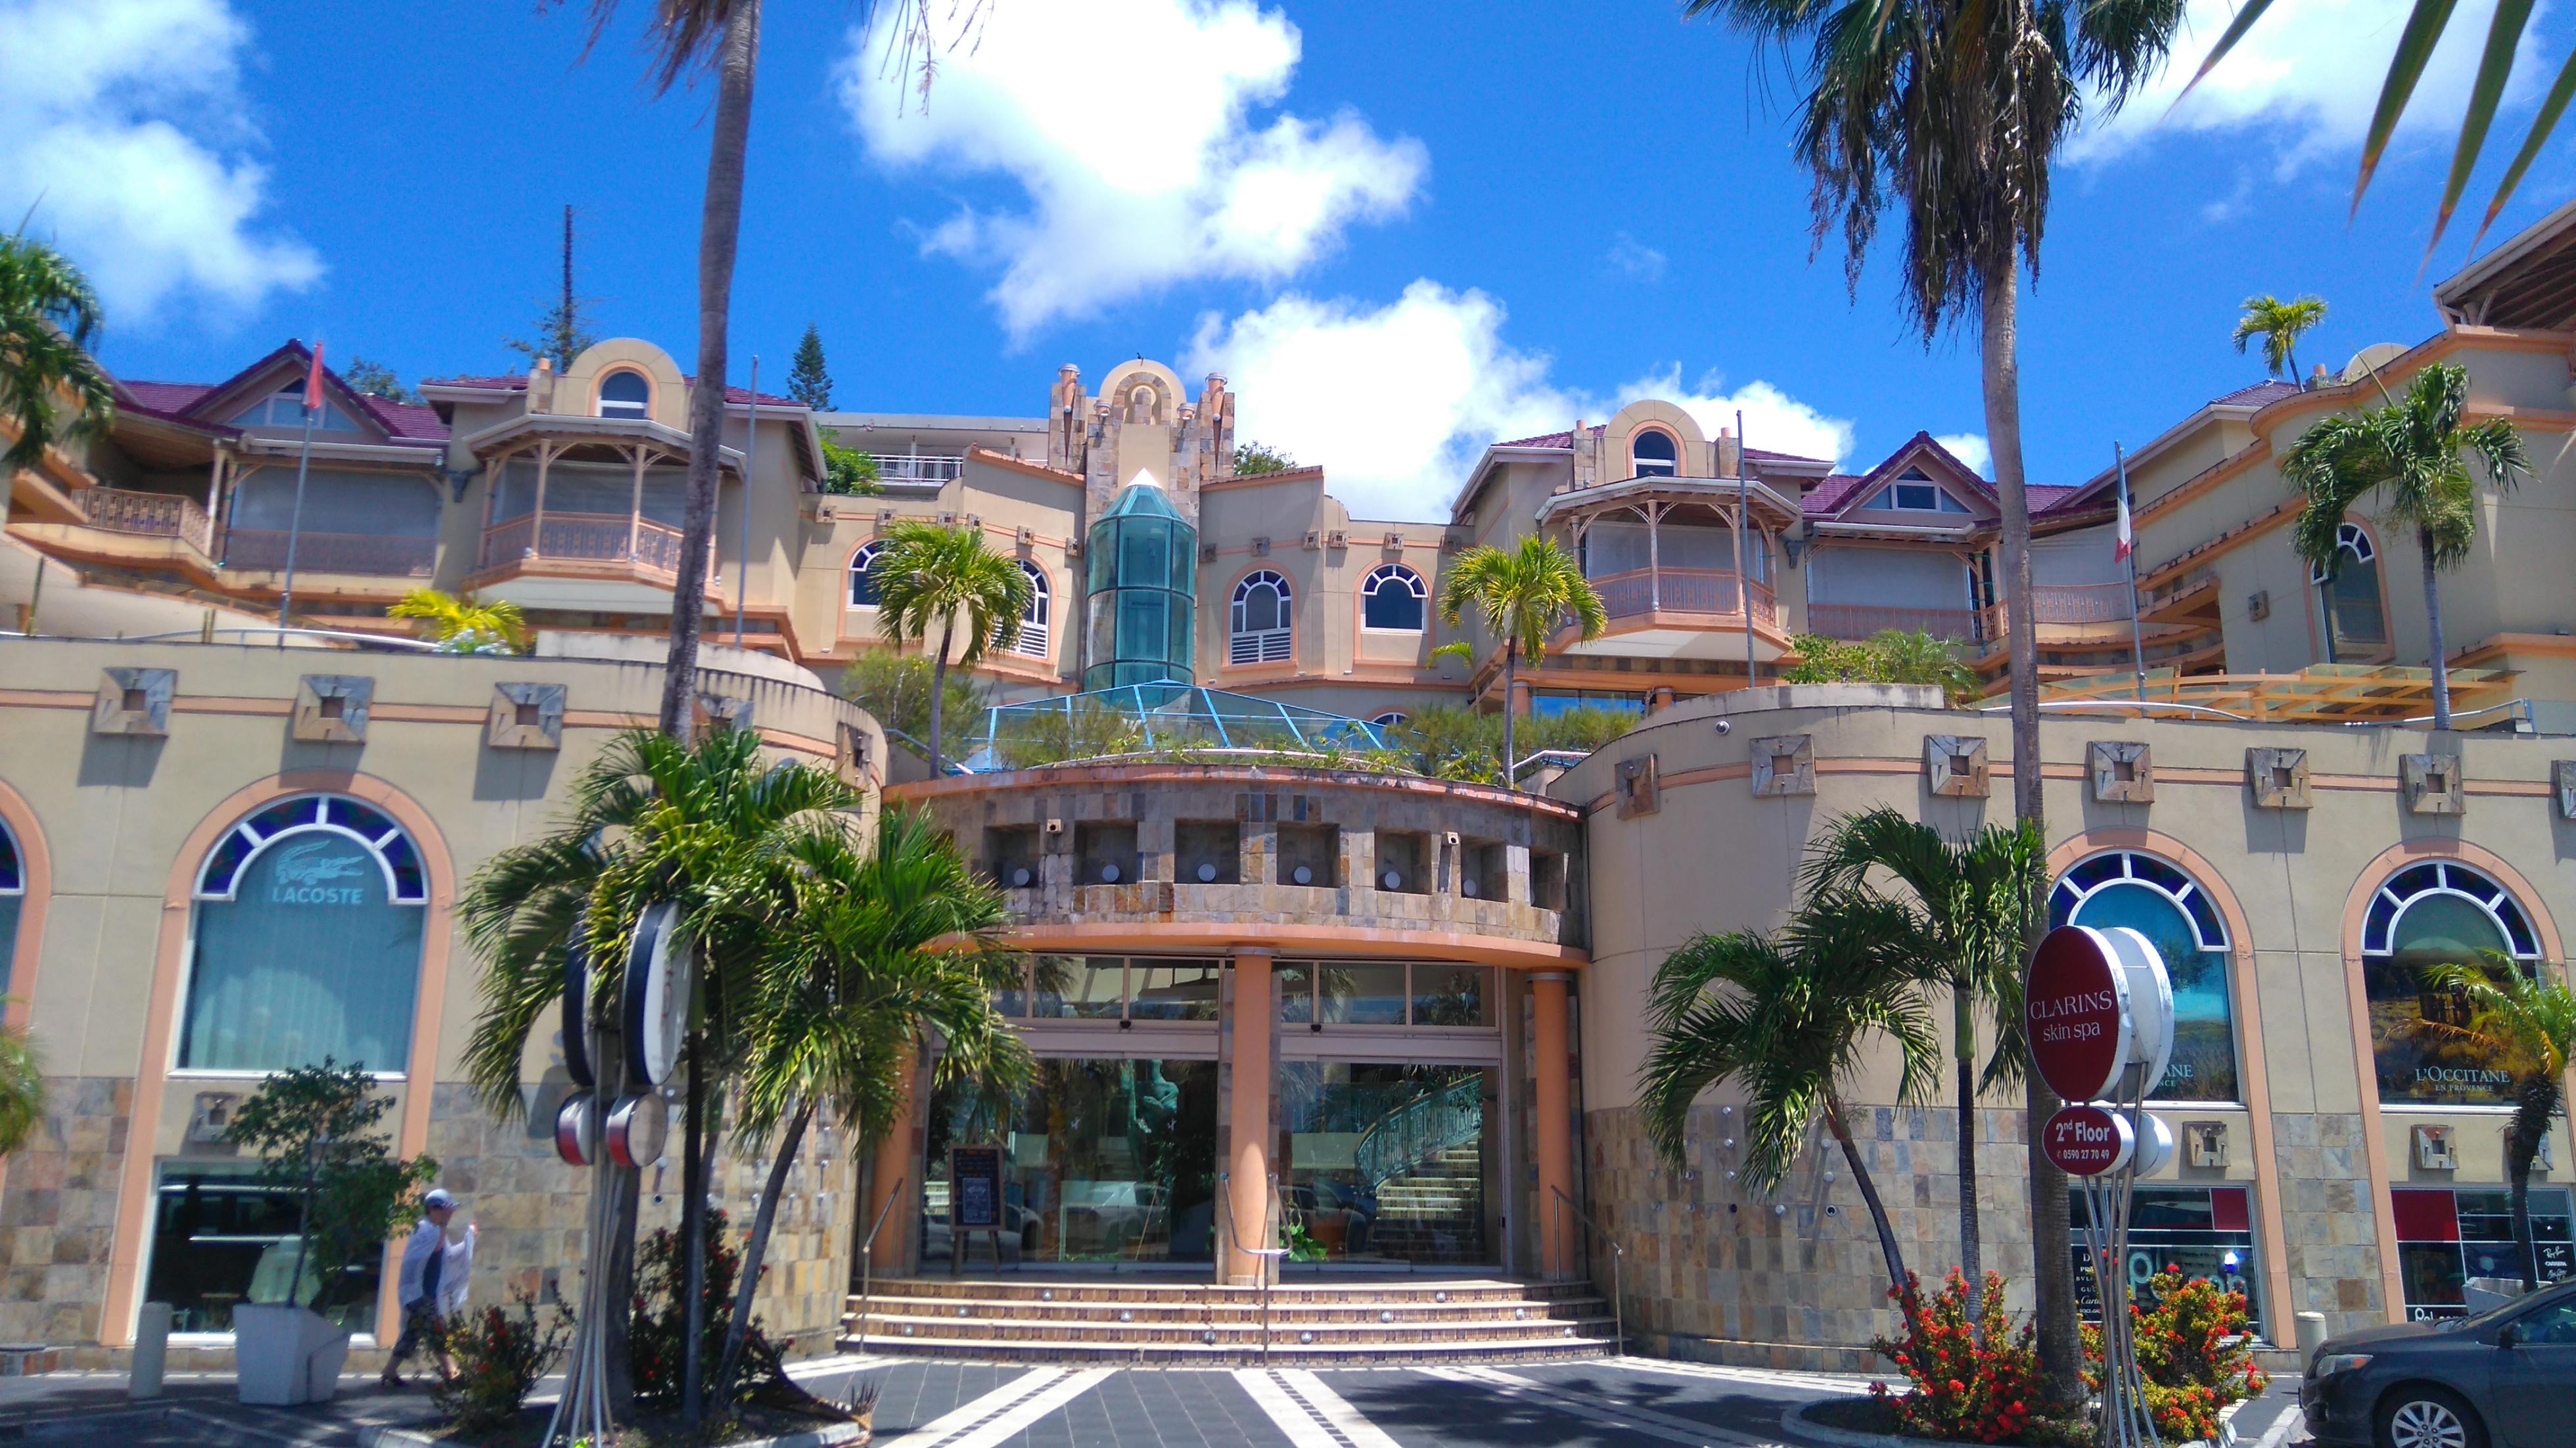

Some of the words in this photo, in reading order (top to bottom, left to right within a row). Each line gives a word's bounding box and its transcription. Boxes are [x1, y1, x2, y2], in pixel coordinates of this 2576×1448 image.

[271, 886, 363, 905] LACOSTE
[2030, 990, 2113, 1020] CLARINS
[2043, 1023, 2071, 1041] skin
[2073, 1021, 2101, 1041] spa
[2414, 1066, 2510, 1083] L'OCCITANE
[2056, 1119, 2073, 1142] 2nd
[2075, 1121, 2110, 1141] Floor
[2063, 1149, 2080, 1160] 0590
[2081, 1149, 2090, 1160] 27
[2091, 1149, 2100, 1160] 70
[2101, 1149, 2110, 1160] 49
